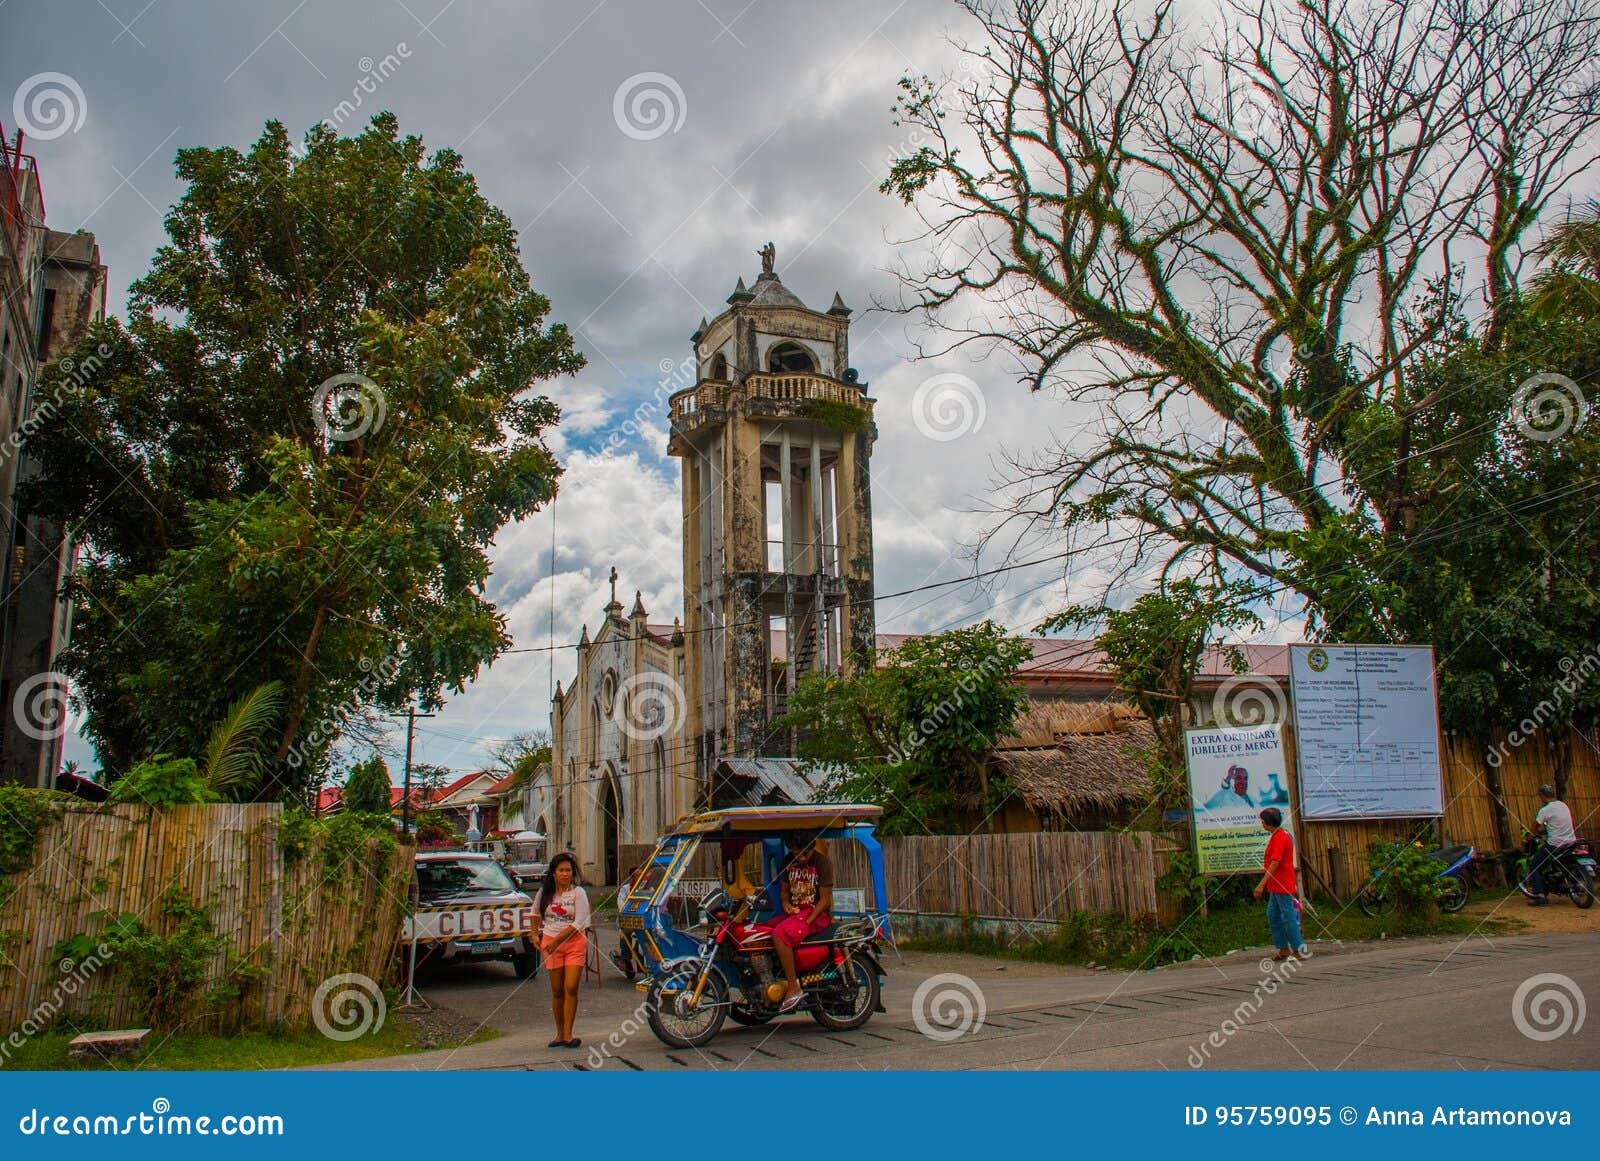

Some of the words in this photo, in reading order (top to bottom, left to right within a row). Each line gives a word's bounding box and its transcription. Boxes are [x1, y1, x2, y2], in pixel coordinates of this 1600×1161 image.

[1191, 735, 1221, 745] EXTRA
[1224, 730, 1276, 742] ORDINARY
[1191, 744, 1228, 757] JUBILEE
[1230, 744, 1242, 752] OF
[1245, 740, 1279, 751] MERCY
